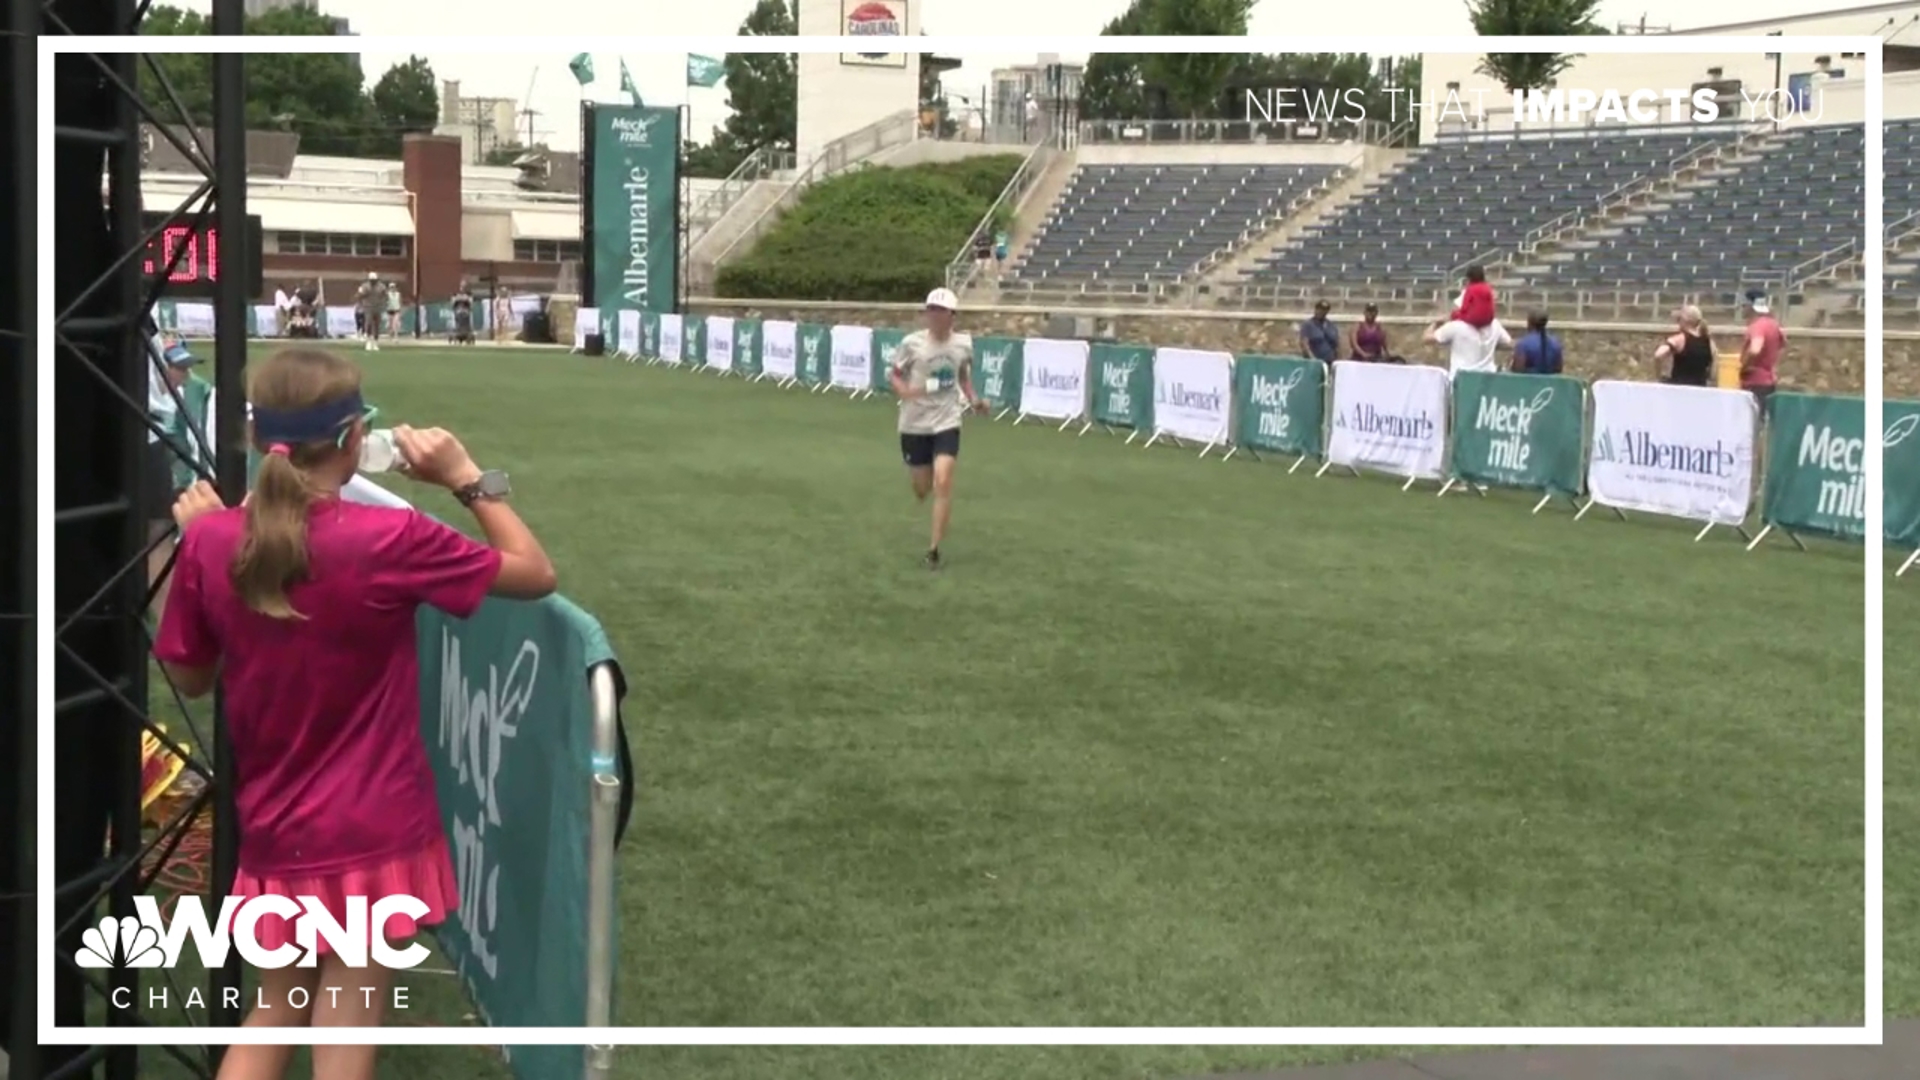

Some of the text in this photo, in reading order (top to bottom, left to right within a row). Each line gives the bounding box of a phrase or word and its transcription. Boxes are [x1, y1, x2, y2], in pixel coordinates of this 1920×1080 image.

[623, 166, 649, 307] Albemarle
[1251, 374, 1290, 408] Meck
[1258, 406, 1291, 438] mile
[1352, 402, 1434, 441] Albemarle
[1475, 395, 1533, 436] Meck
[1487, 434, 1530, 471] mile
[1619, 429, 1734, 478] Albemarle
[1798, 423, 1866, 474] Mec
[1816, 474, 1866, 520] mil
